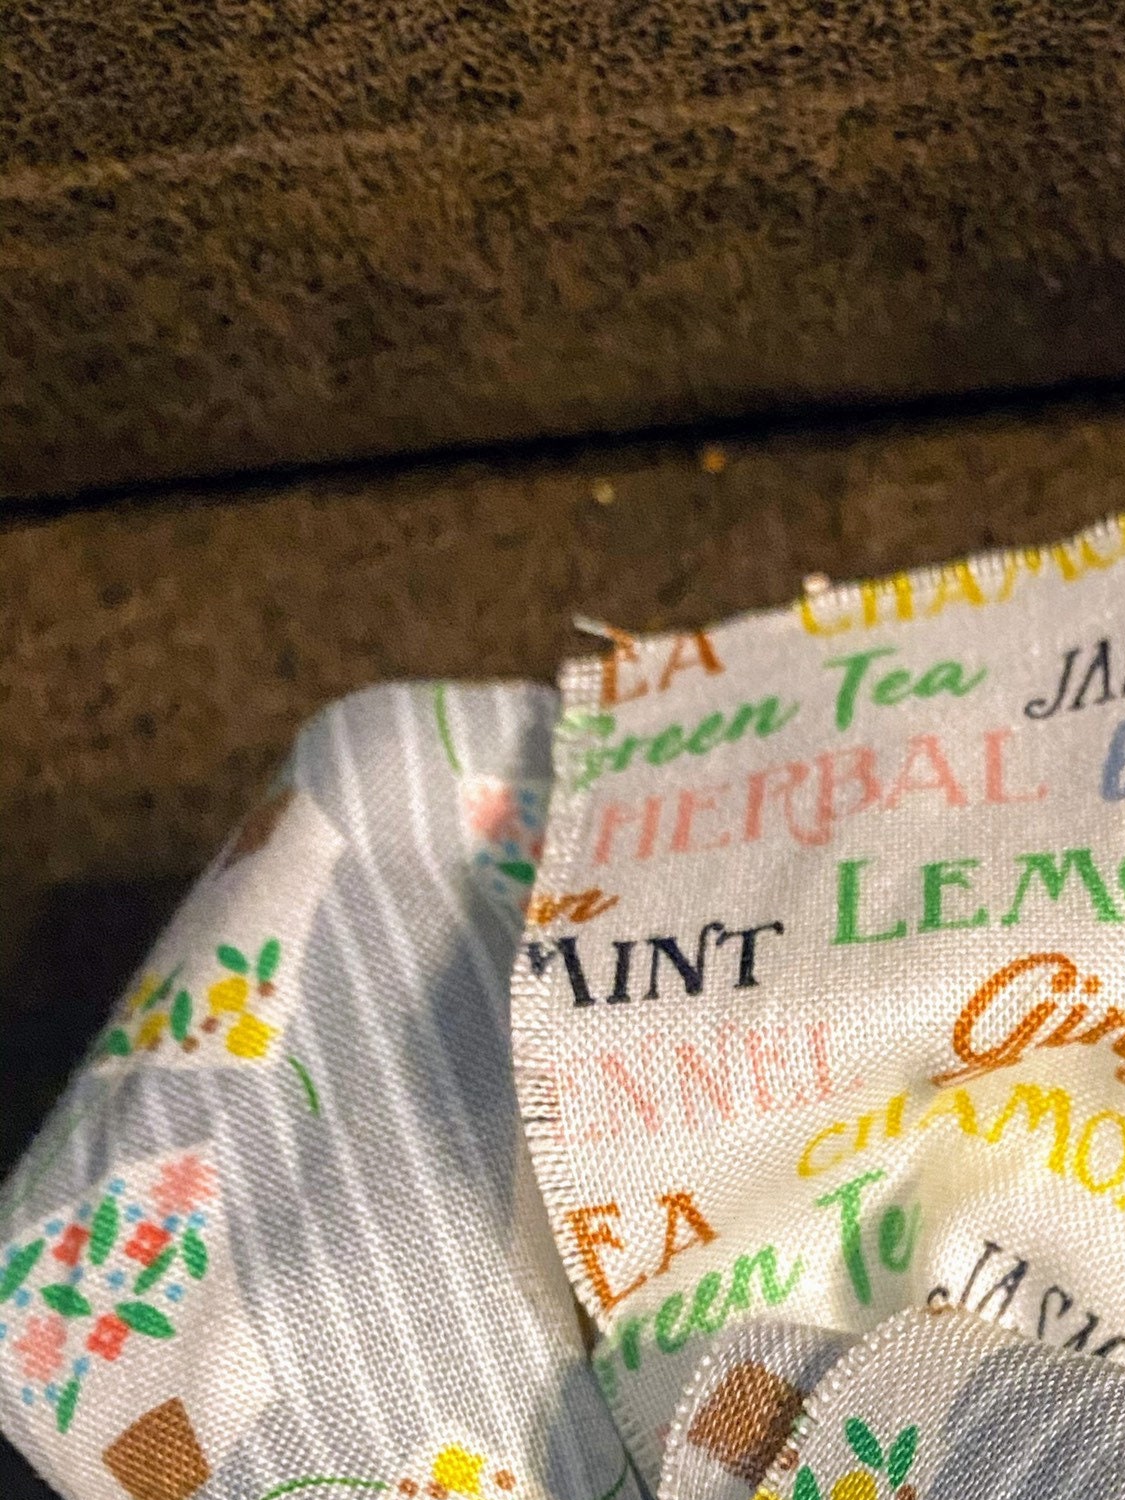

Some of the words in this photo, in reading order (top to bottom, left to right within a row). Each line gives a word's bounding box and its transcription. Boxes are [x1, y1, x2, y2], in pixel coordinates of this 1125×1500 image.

[822, 646, 988, 731] Tea
[595, 728, 1050, 864] HERBAL
[566, 1190, 719, 1310] EA
